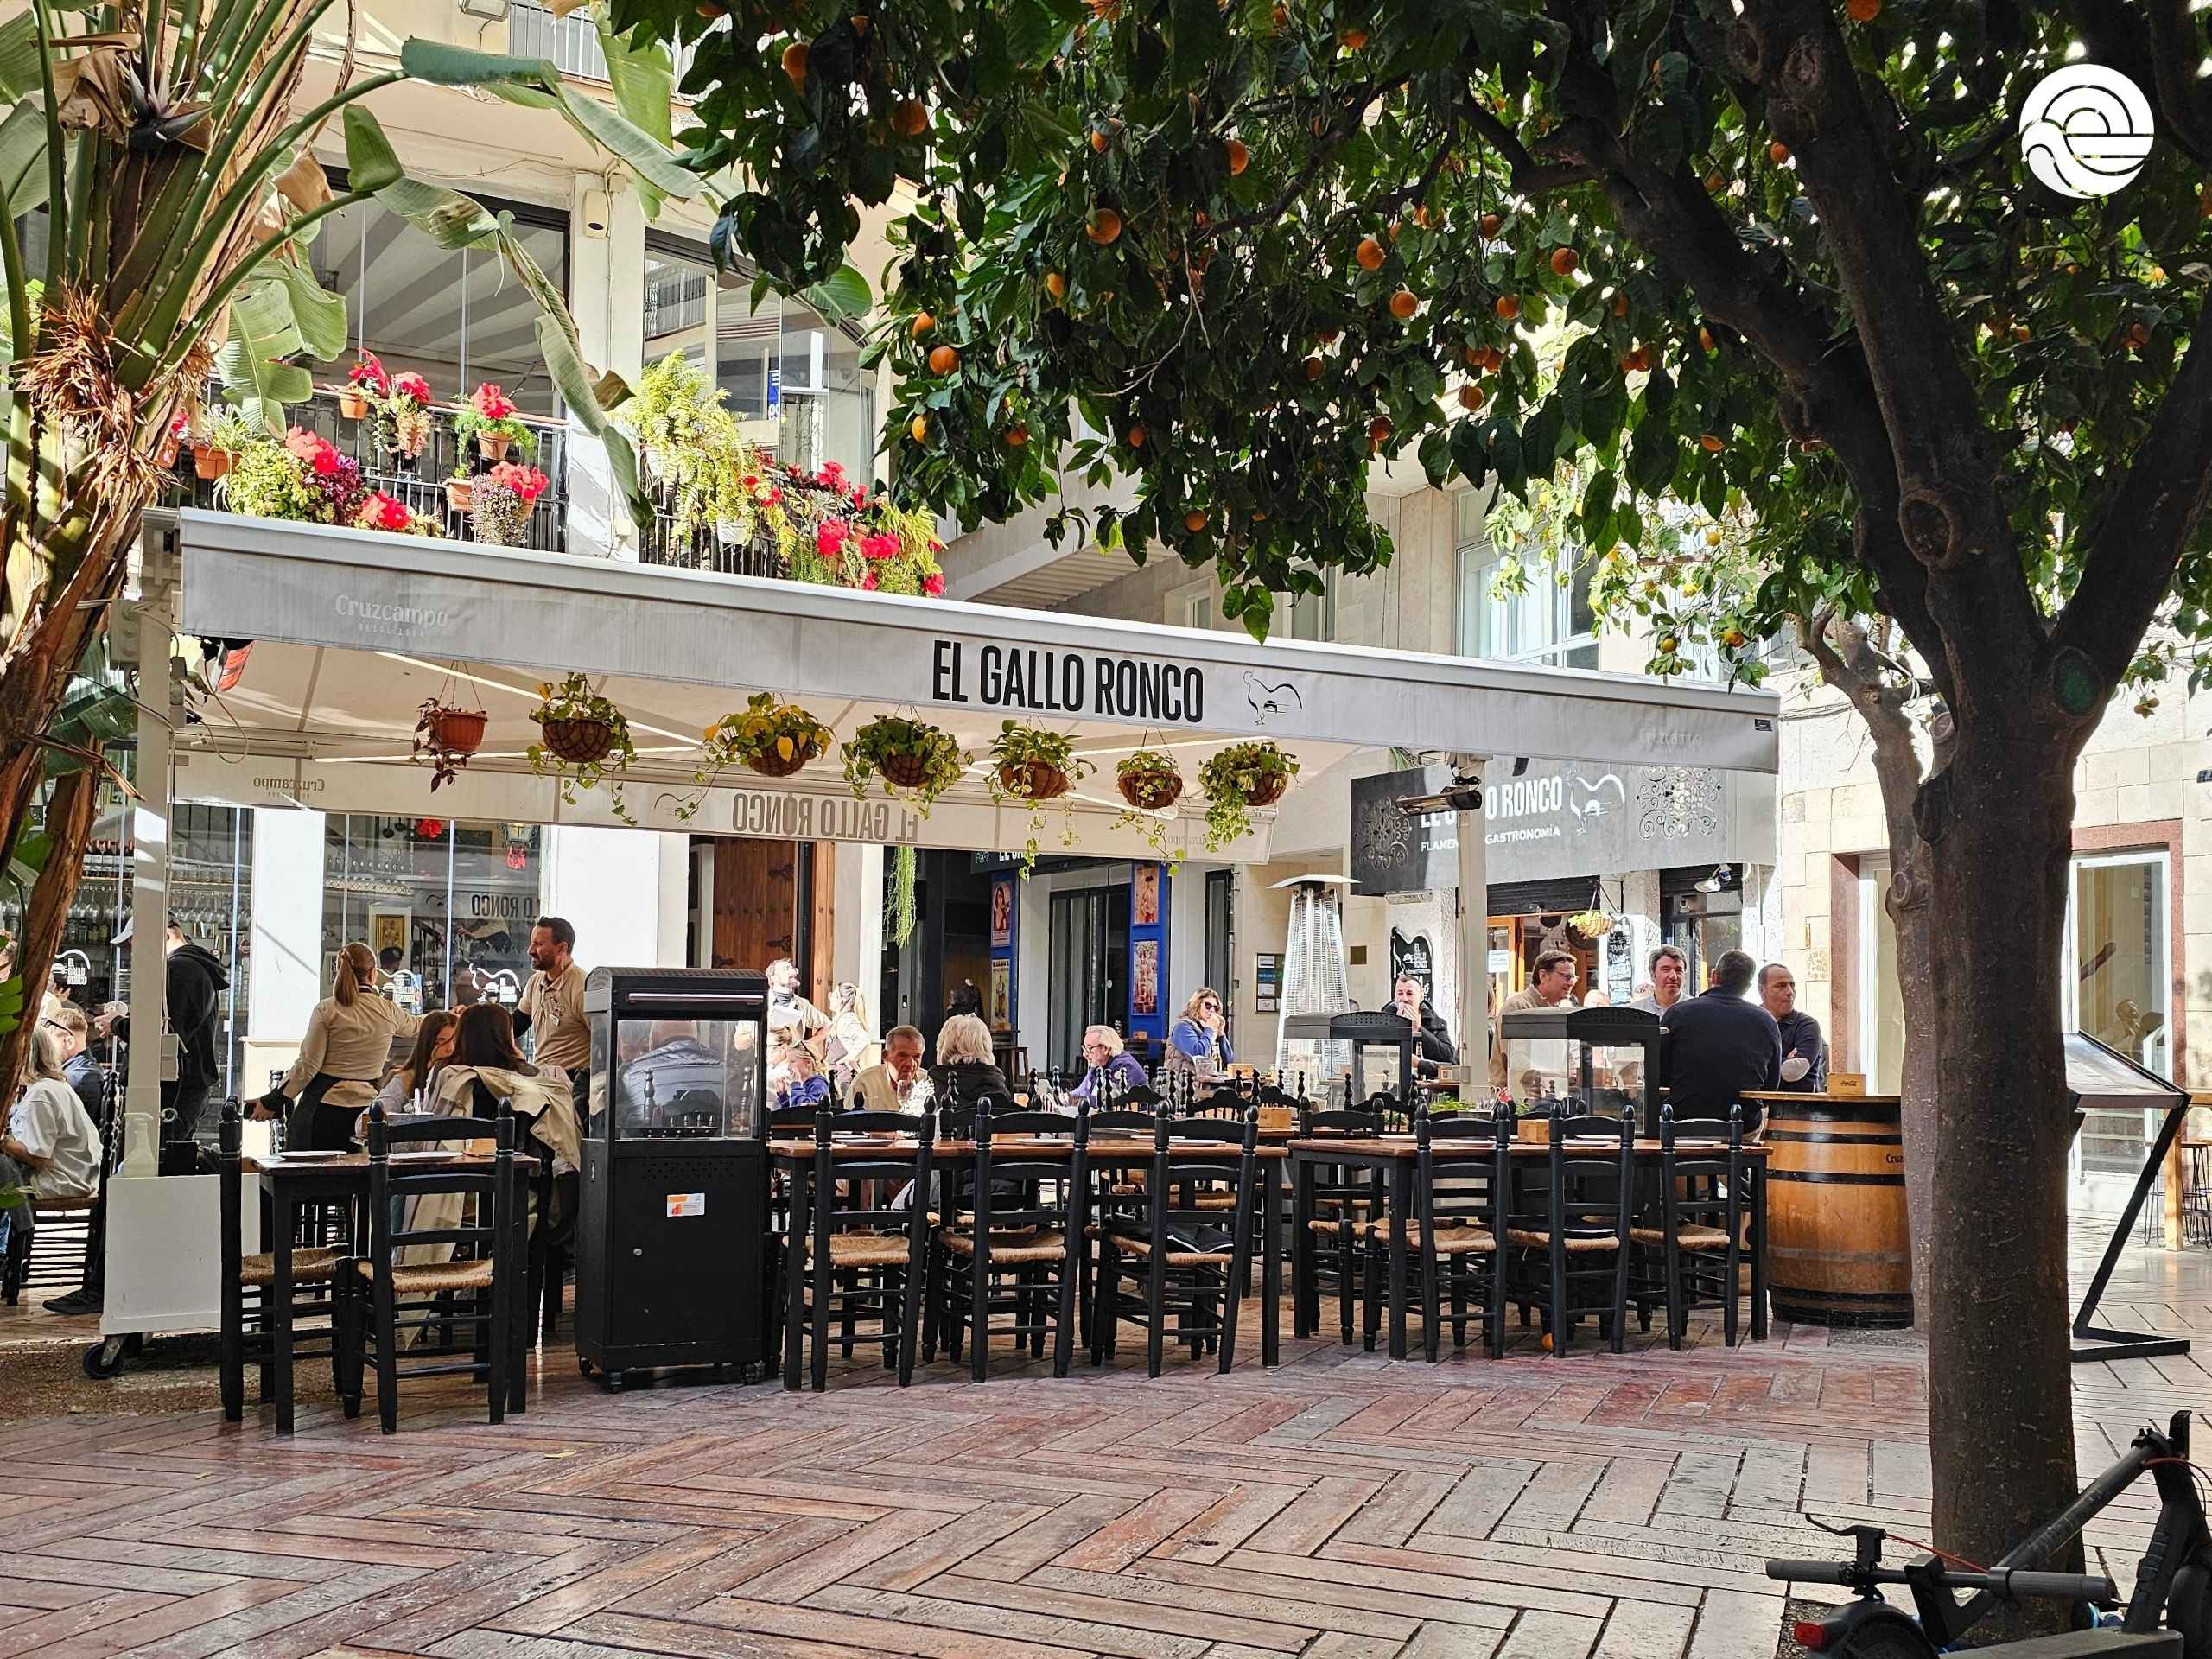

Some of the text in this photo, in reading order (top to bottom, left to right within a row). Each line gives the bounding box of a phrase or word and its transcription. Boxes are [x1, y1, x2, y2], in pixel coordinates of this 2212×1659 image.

[335, 594, 448, 627] Cruzcampo
[932, 639, 1204, 723] EL GALLO RONCO
[1502, 776, 1563, 818] RONCO
[1484, 823, 1561, 845] GASTRONOMÍA
